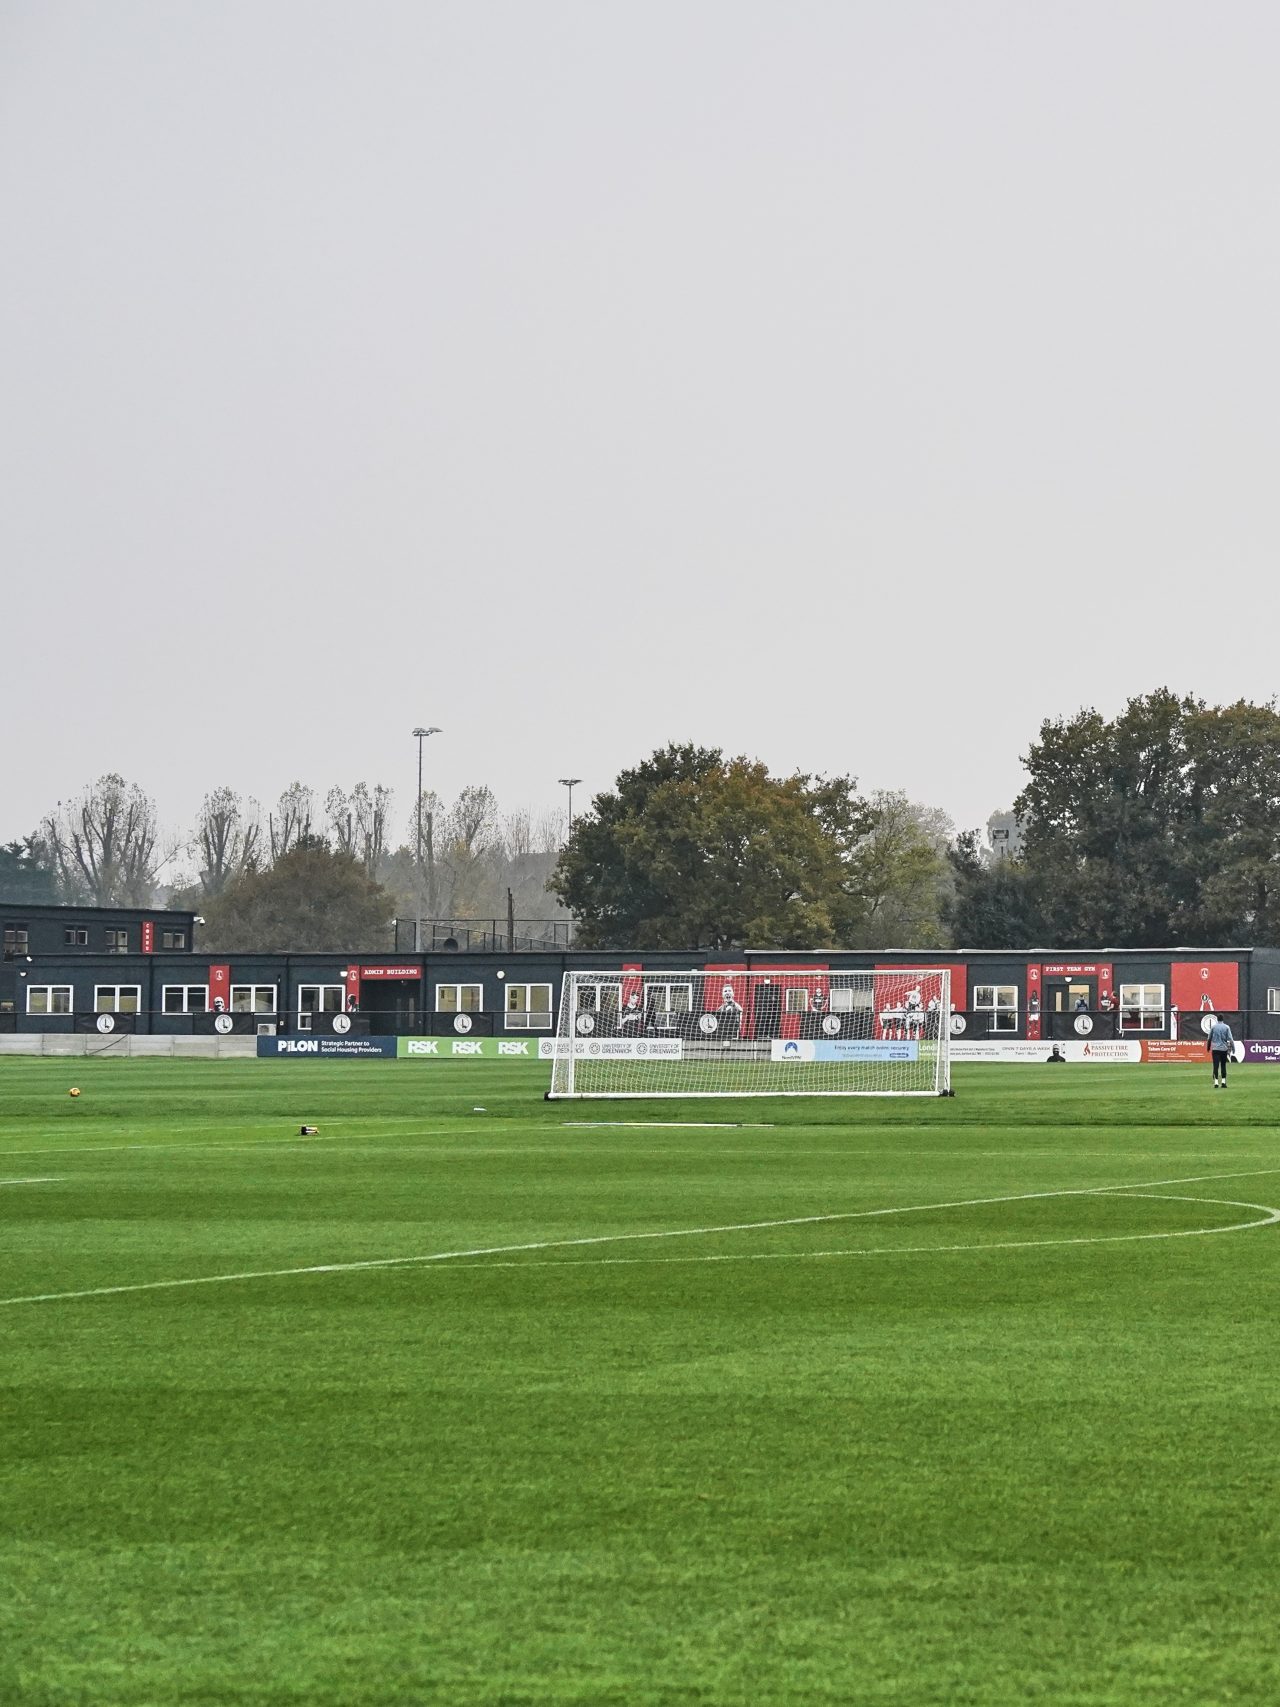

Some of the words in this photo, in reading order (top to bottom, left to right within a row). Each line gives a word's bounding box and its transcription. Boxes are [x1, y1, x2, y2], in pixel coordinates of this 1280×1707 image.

[407, 1040, 439, 1054] RSK
[451, 1041, 483, 1054] RSK
[497, 1041, 529, 1055] RSK
